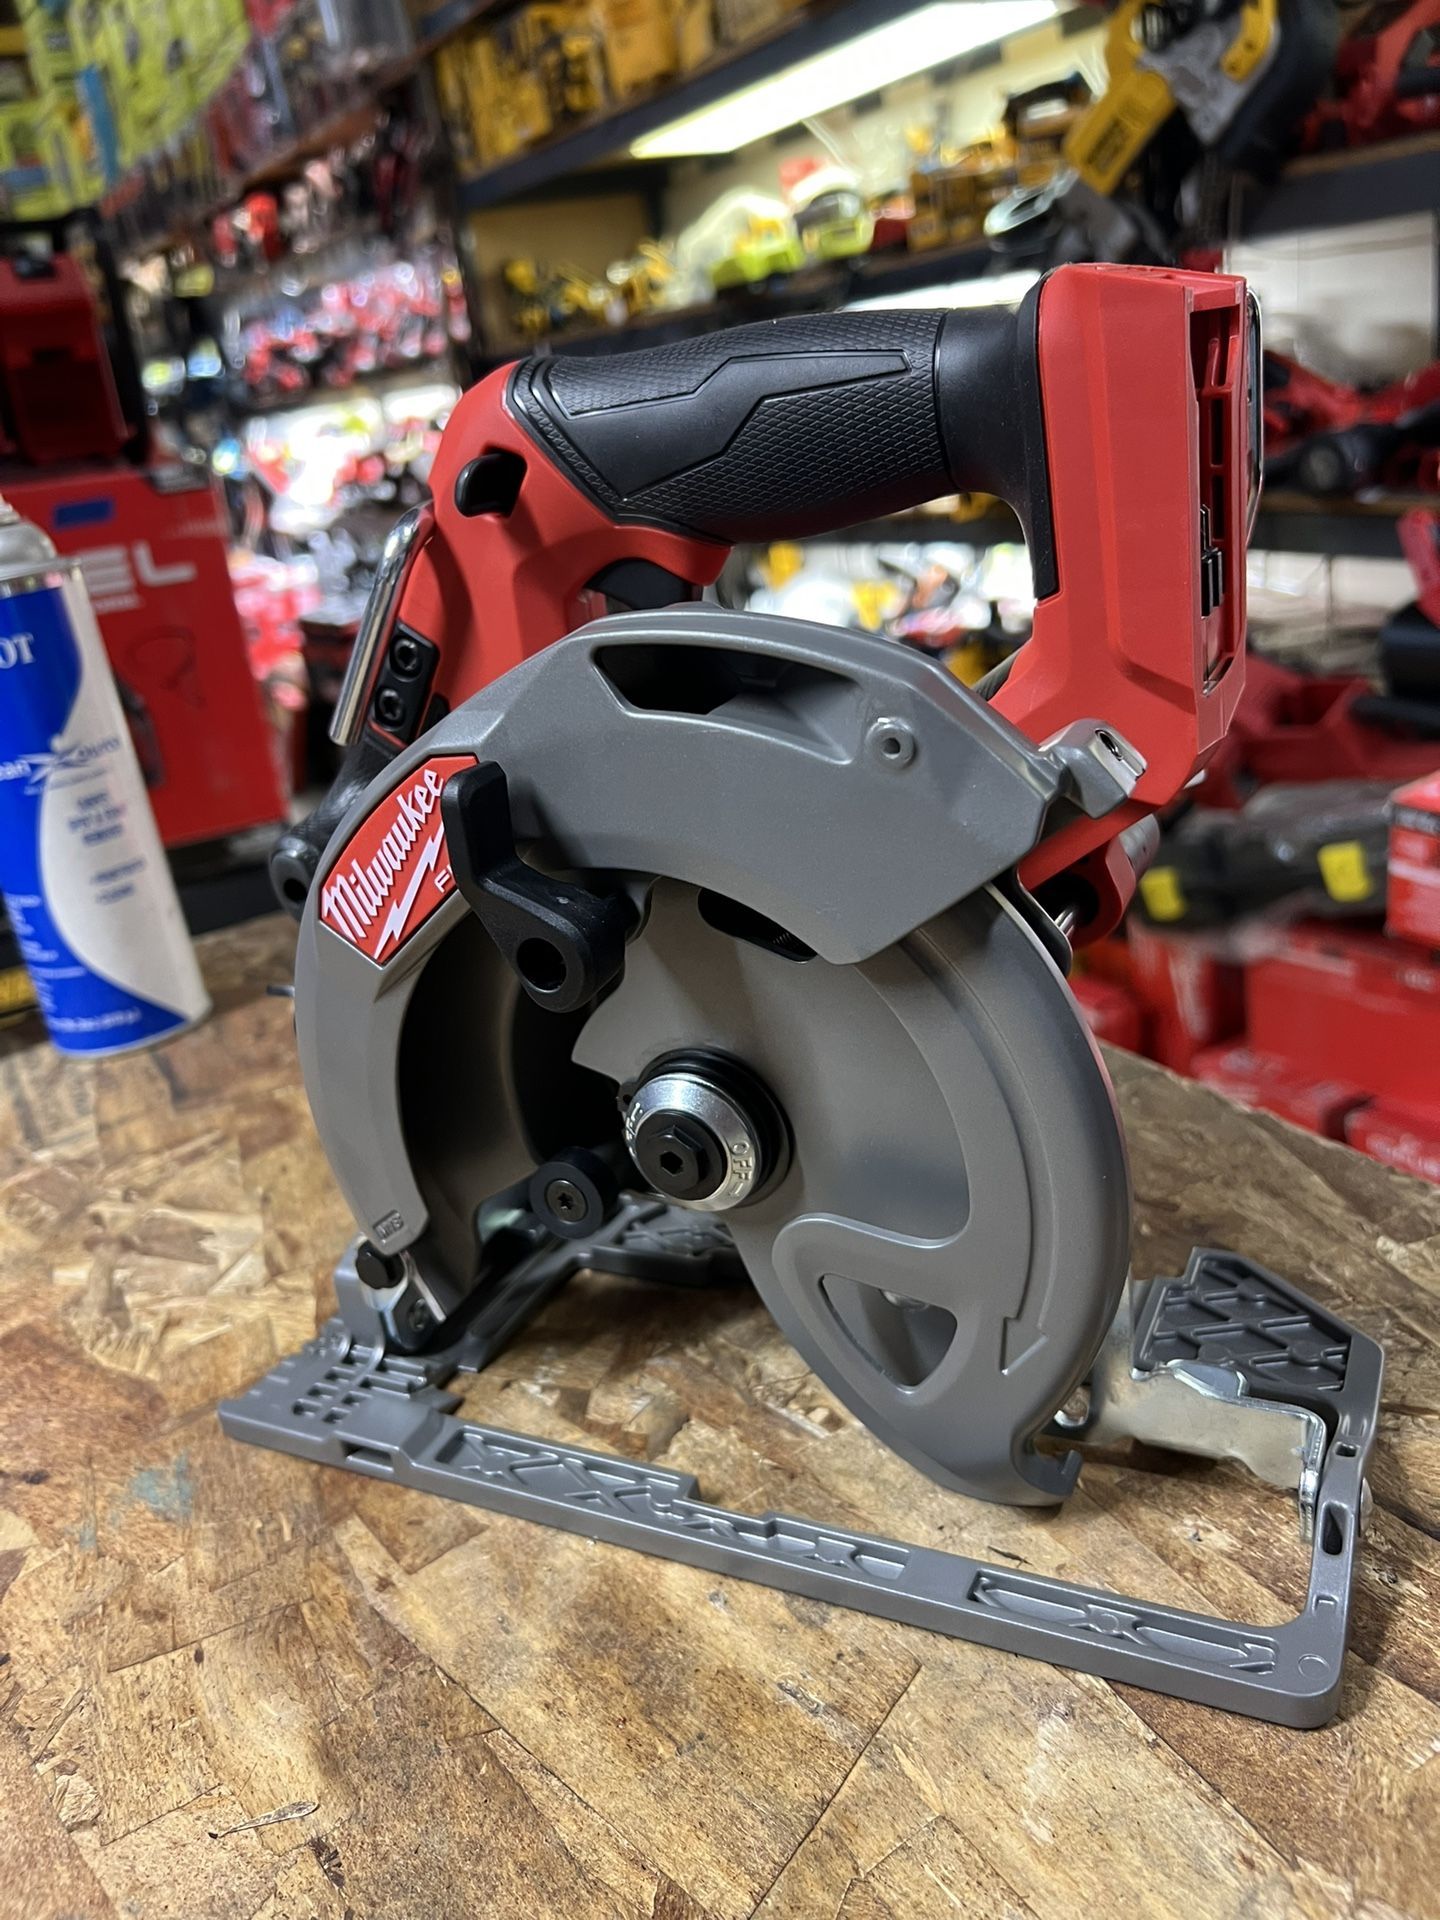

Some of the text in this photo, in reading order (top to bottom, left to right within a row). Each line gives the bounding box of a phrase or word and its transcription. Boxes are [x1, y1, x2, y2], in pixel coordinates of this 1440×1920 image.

[322, 769, 444, 943] Milwaukee
[434, 863, 454, 893] F
[730, 1141, 754, 1181] OFF
